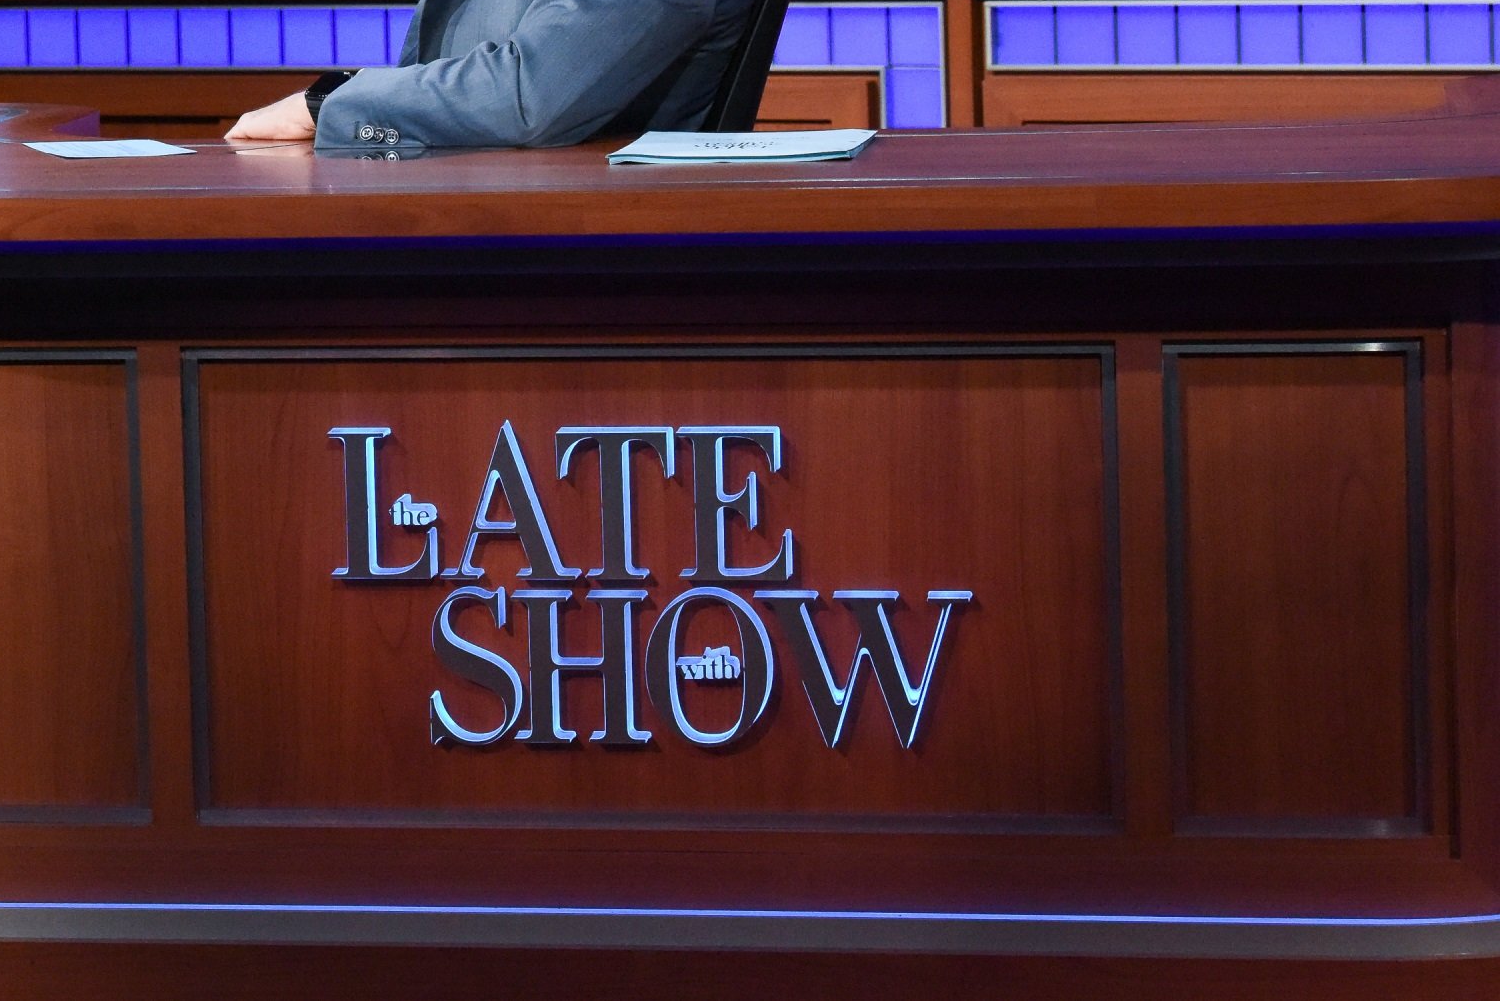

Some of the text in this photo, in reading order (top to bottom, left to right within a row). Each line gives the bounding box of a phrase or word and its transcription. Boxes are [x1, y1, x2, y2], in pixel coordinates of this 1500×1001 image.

[327, 420, 794, 580] the LATE
[430, 587, 973, 748] SHOW with
